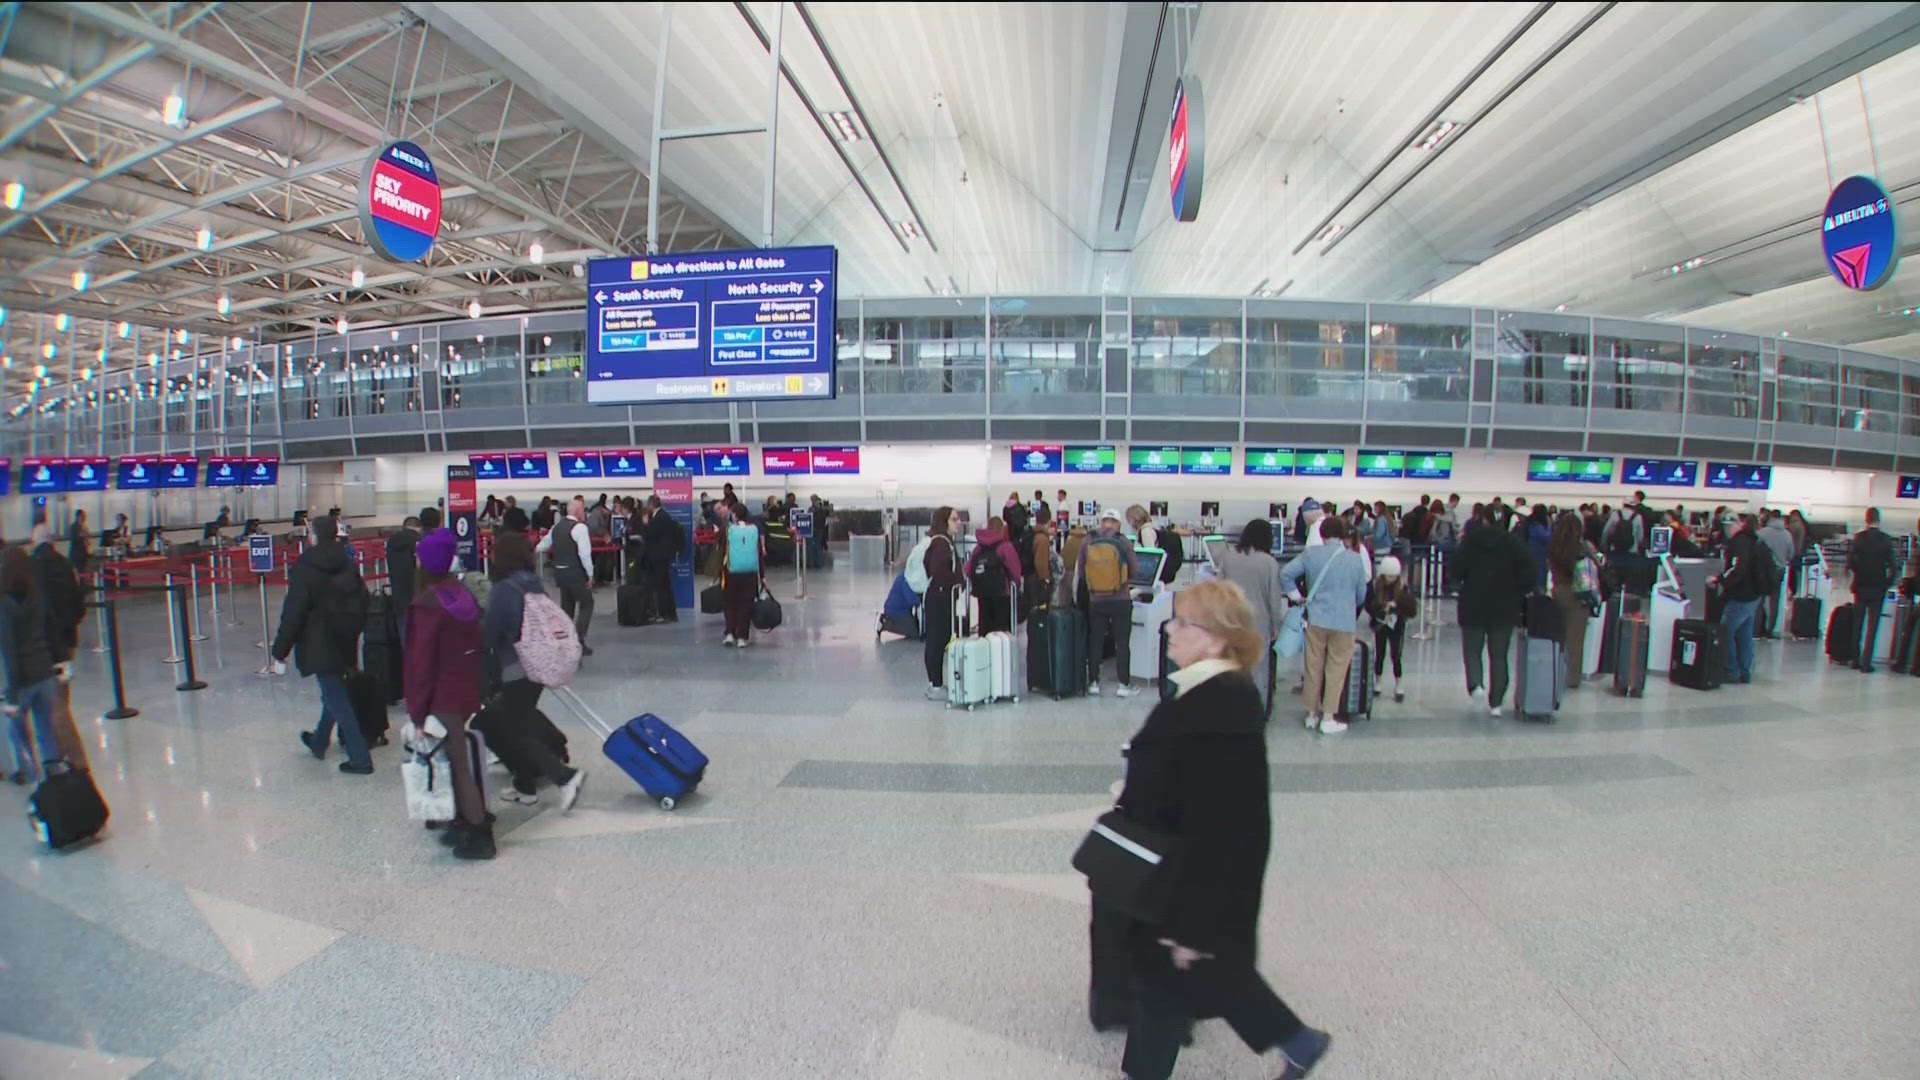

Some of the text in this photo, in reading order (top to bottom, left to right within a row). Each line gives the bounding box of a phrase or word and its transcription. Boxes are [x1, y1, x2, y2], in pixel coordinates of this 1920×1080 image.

[375, 172, 402, 195] SKY
[373, 186, 432, 221] PRIORITY
[1835, 202, 1878, 227] DELTA
[651, 257, 785, 275] Both directions to All Gates
[613, 287, 684, 302] South Security
[728, 281, 803, 296] North Security
[656, 381, 782, 394] Restrooms Elevators
[252, 547, 270, 556] EXIT
